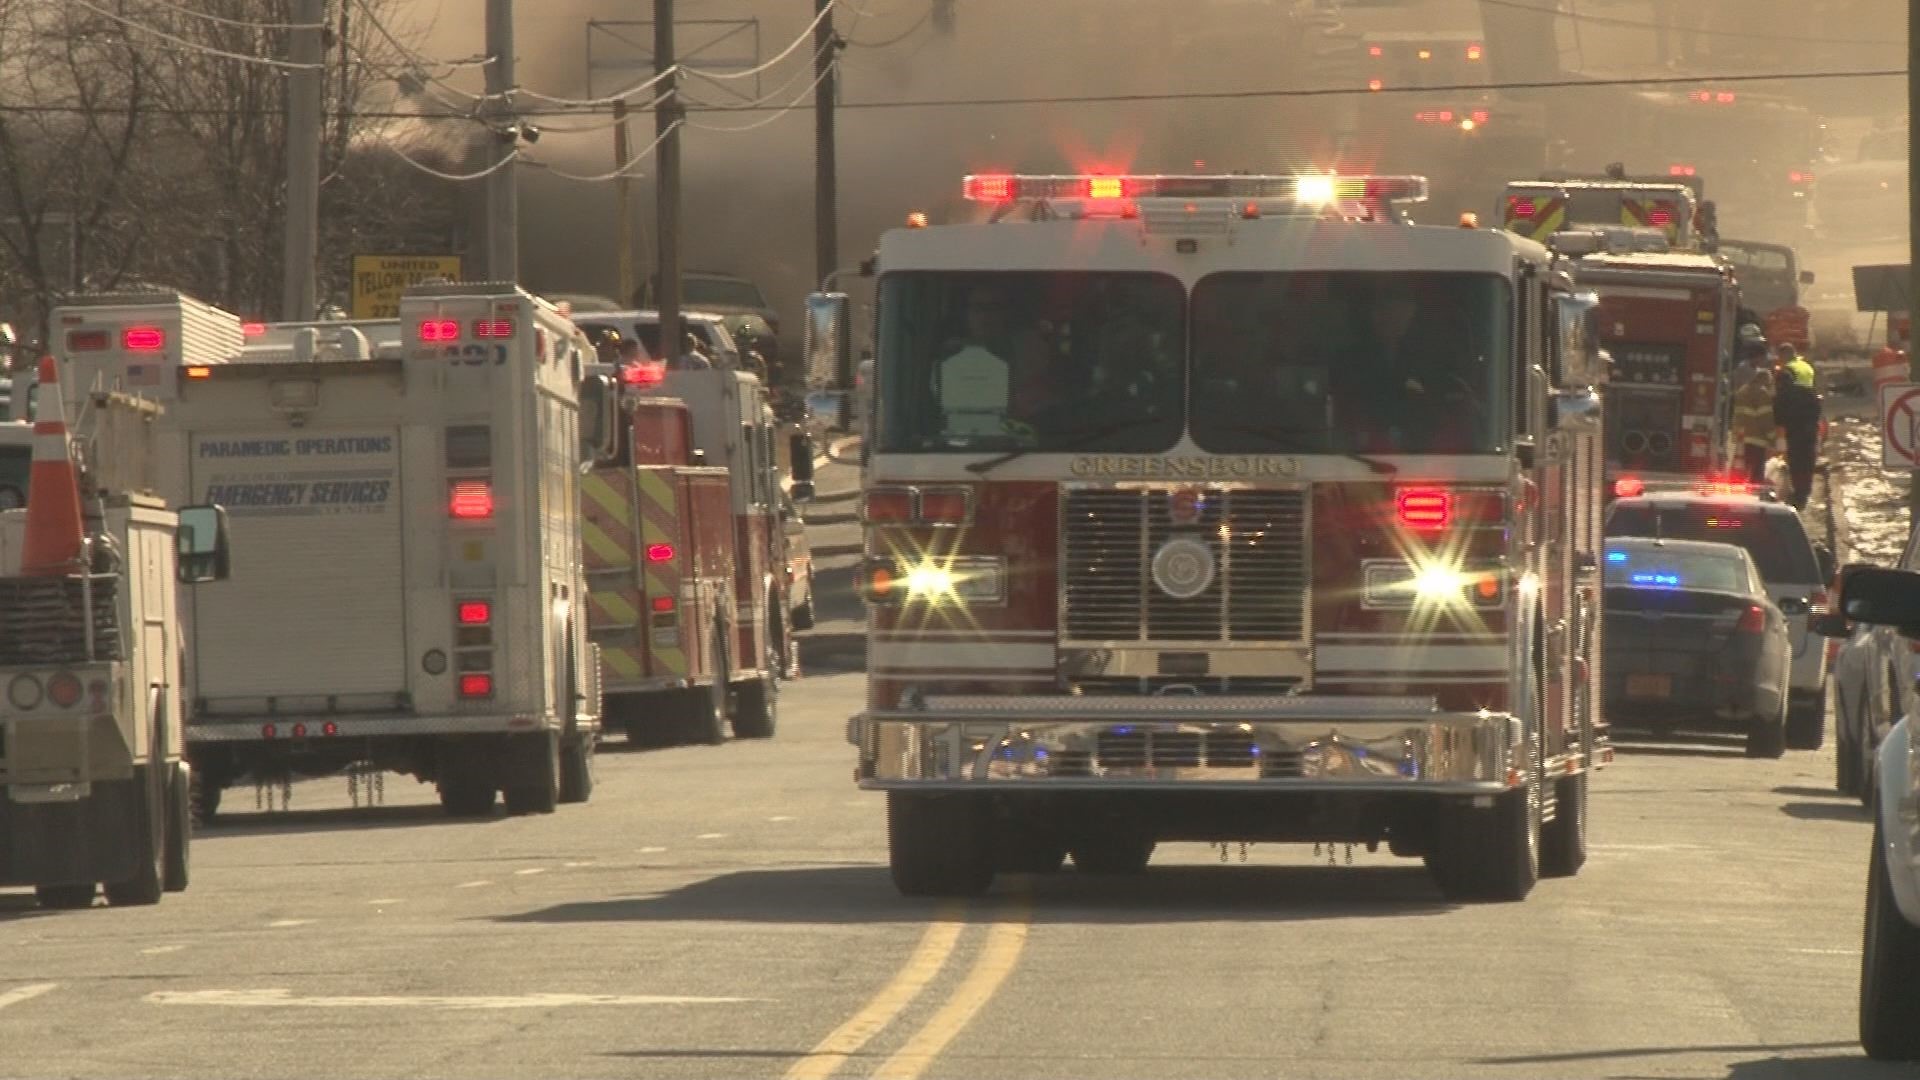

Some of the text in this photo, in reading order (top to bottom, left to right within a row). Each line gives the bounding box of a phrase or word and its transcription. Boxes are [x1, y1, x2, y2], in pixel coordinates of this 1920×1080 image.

[381, 260, 440, 271] UNITED
[357, 271, 405, 296] YELLOW
[200, 436, 392, 458] PARAMEDIC OPERATIONS
[1070, 456, 1299, 477] GREENSBORO
[206, 480, 391, 506] EMERGENCY SERVICES
